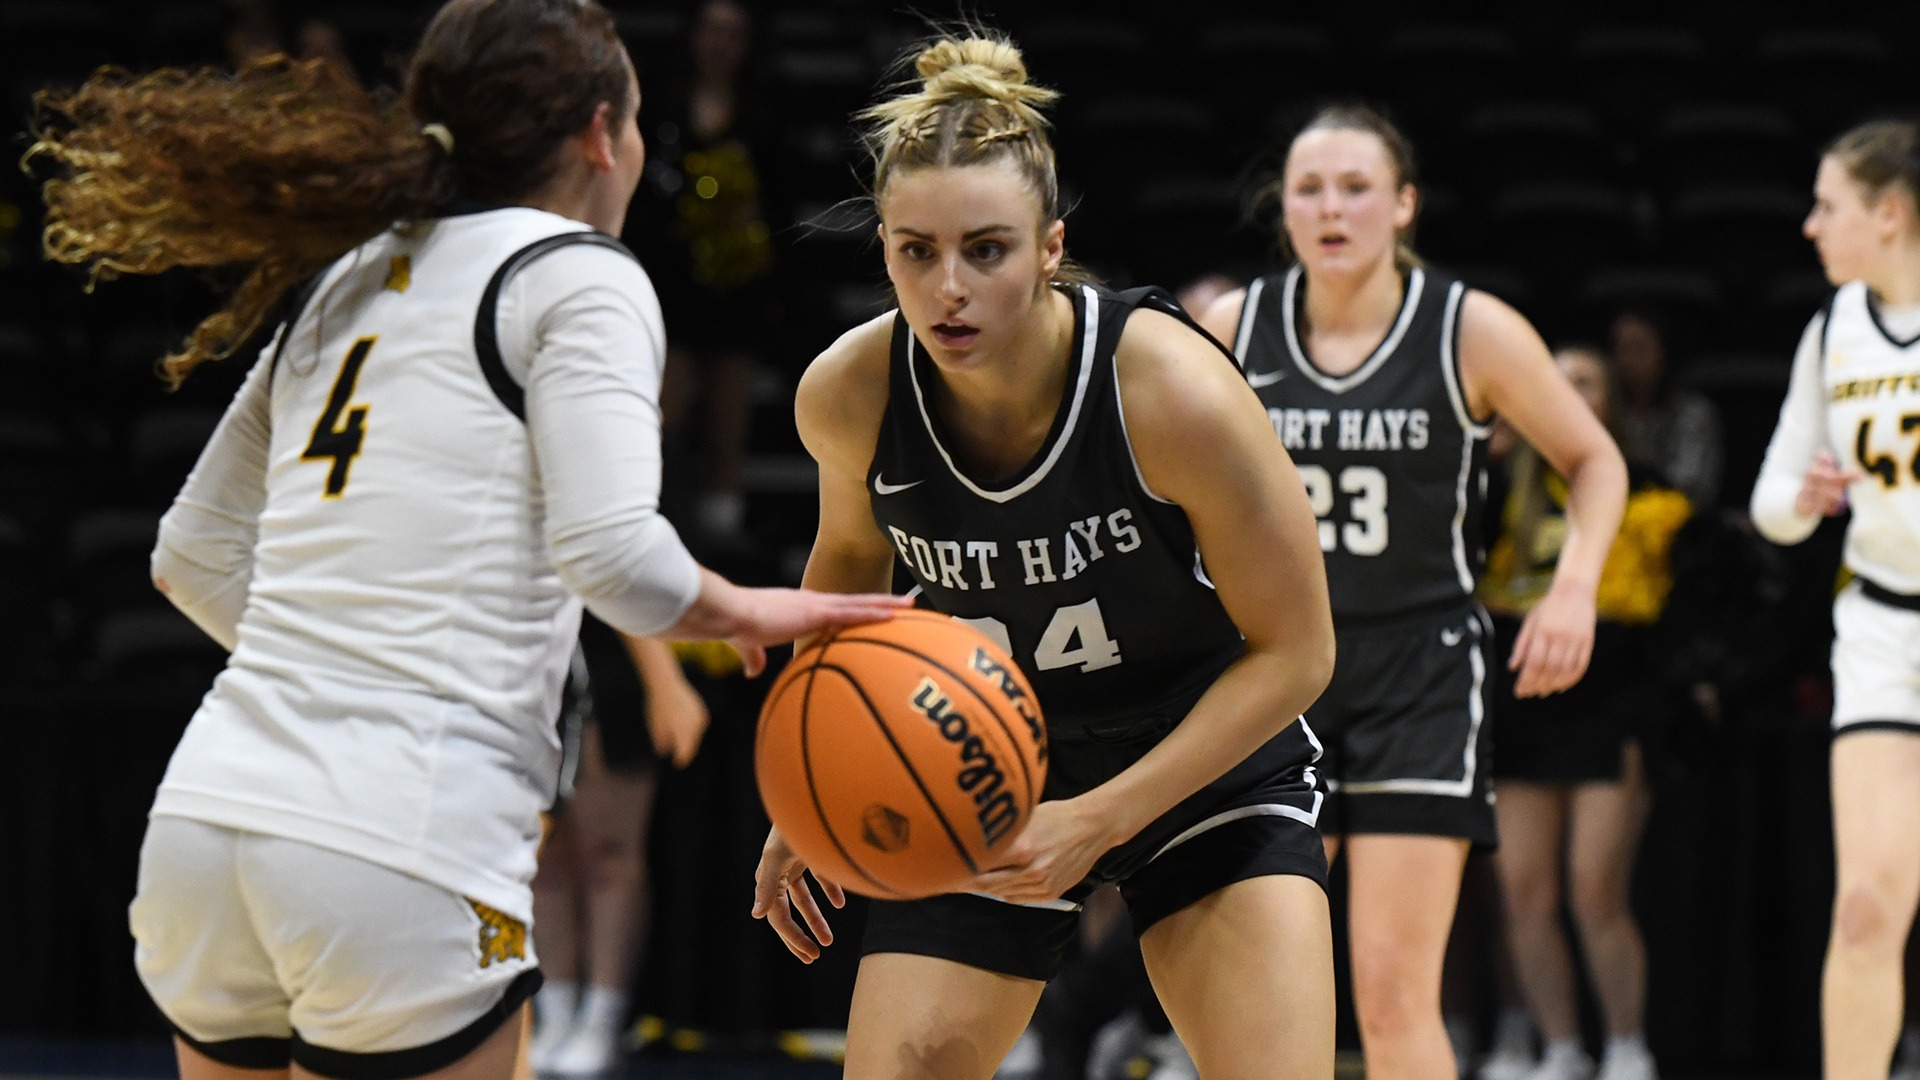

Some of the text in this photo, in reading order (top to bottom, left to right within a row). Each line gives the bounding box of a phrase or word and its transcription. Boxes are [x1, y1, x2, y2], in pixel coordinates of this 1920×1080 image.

[299, 333, 380, 501] 4
[1267, 407, 1431, 451] ORT HAYS
[887, 507, 1143, 591] FORT HAYS
[909, 676, 1021, 850] Wilson
[966, 646, 1049, 768] CAA
